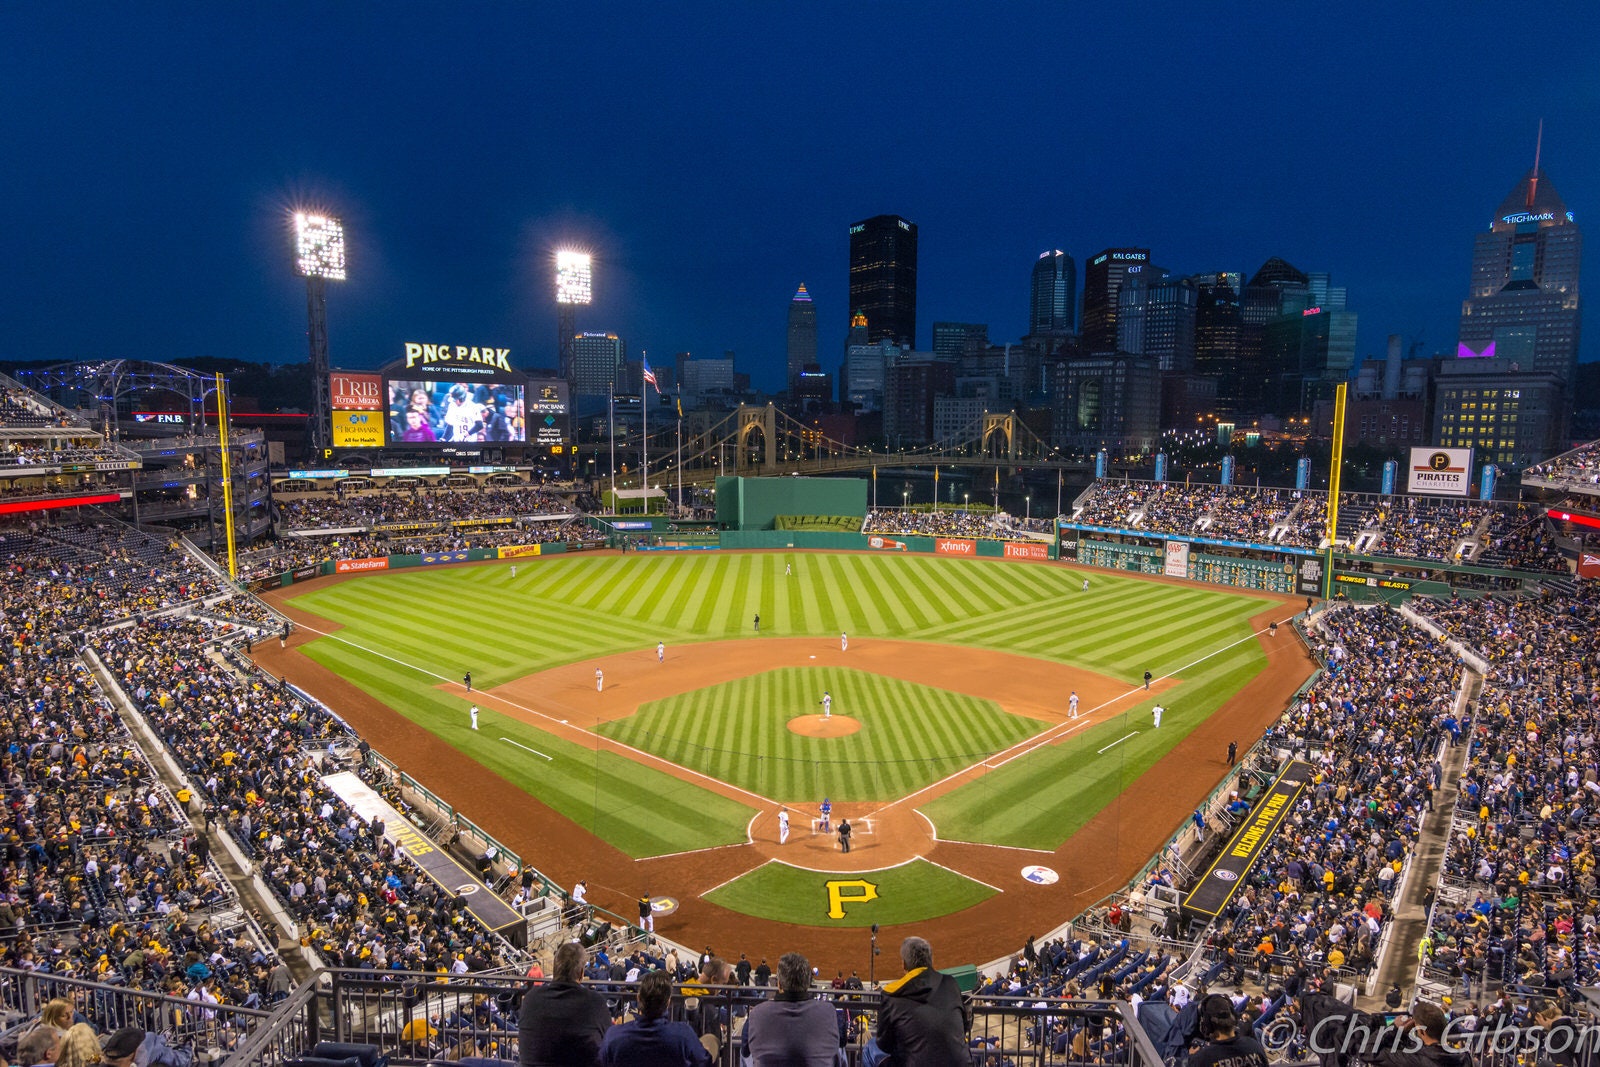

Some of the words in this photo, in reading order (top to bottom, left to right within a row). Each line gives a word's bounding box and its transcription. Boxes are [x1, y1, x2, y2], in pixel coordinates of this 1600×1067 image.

[1505, 212, 1554, 224] HIGHMARK
[404, 342, 452, 369] PNC
[455, 345, 512, 373] PARK
[333, 377, 379, 396] TRIB
[334, 395, 358, 404] TOTAL
[358, 396, 380, 405] MEDIA
[339, 425, 380, 434] HIGHMARK
[324, 448, 333, 459] P
[572, 446, 578, 455] P
[1434, 456, 1445, 468] P
[1417, 473, 1460, 482] PIRATES
[1416, 480, 1459, 488] CHARITIES
[940, 541, 971, 552] xfinity
[1004, 545, 1029, 557] TRIB
[1086, 543, 1122, 553] NATIONAL
[1124, 548, 1154, 557] LEAGUE
[1167, 543, 1182, 553] AAA
[1198, 558, 1244, 568] AMERICAN
[1246, 561, 1283, 573] LEAGUE
[1340, 575, 1367, 584] BOWSER
[1383, 581, 1410, 590] BLASTS
[1266, 792, 1289, 809] PARK
[1258, 806, 1279, 821] PNC
[1255, 818, 1269, 827] TO
[386, 819, 434, 856] PIRATES
[1230, 825, 1266, 858] WELCOME
[824, 878, 881, 919] P
